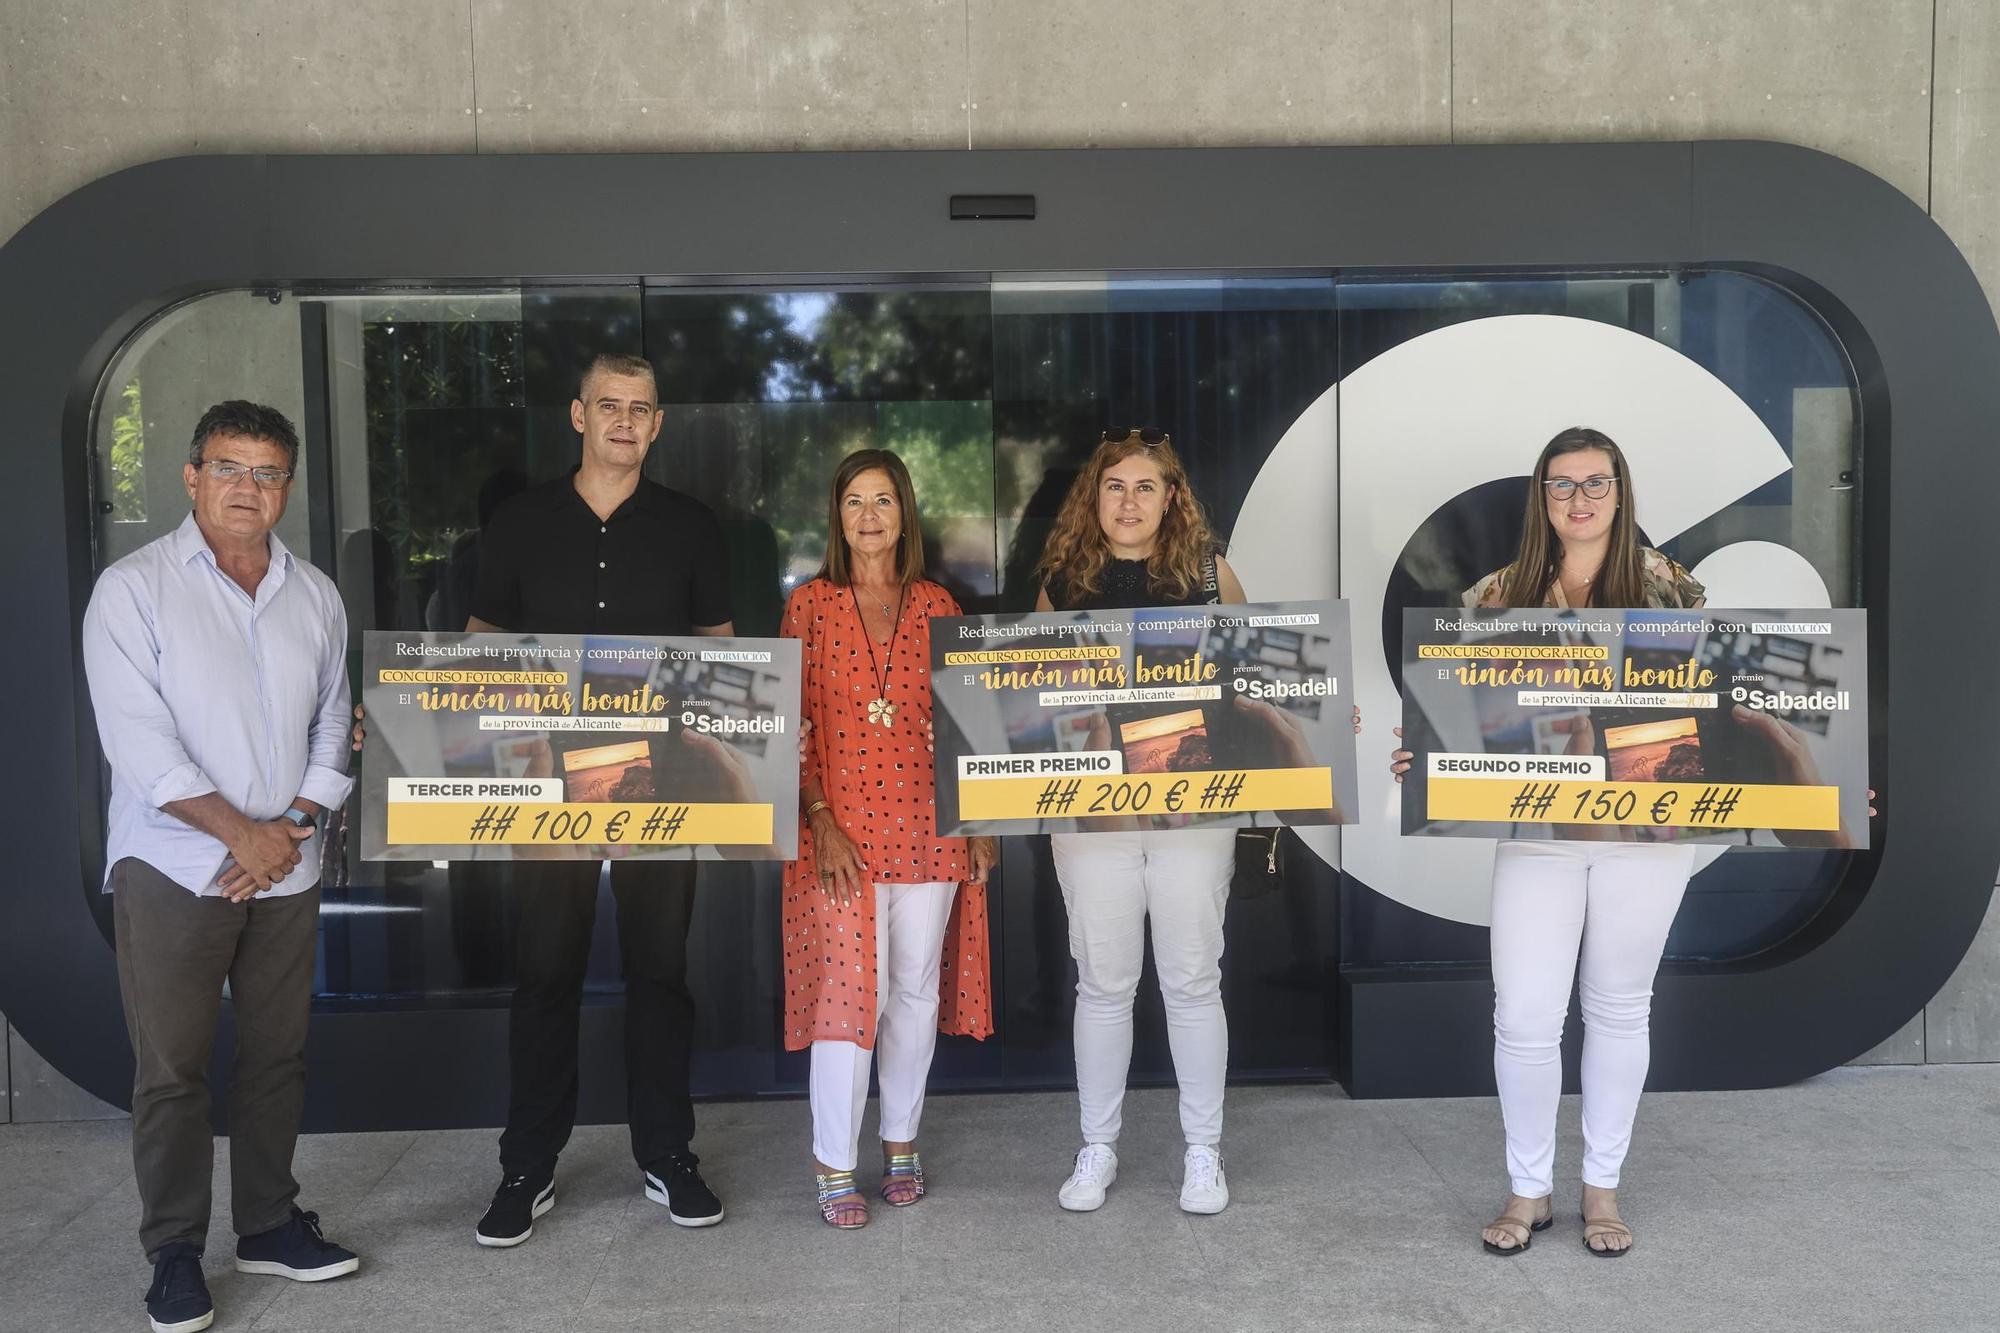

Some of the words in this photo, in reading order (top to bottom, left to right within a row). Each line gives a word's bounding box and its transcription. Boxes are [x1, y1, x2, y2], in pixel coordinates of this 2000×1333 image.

[958, 625, 1037, 639] Redescubre
[1040, 625, 1055, 635] tu
[1058, 621, 1122, 638] provincia
[1126, 623, 1135, 635] y
[1138, 616, 1216, 633] compártelo
[1219, 617, 1244, 628] con
[1252, 614, 1317, 625] INFORMACIÓN
[1435, 618, 1518, 632] Redescubre
[1522, 621, 1537, 632] tu
[1541, 619, 1611, 636] provincia
[1616, 623, 1625, 637] y
[1628, 620, 1715, 636] compártelo
[1718, 622, 1746, 633] con
[396, 643, 480, 657] Redescubre
[484, 646, 499, 657] tu
[503, 645, 571, 662] provincia
[575, 649, 584, 663] y
[588, 646, 667, 662] compártelo
[670, 650, 696, 660] con
[948, 651, 1021, 664] CONCURSO
[1422, 646, 1500, 658] CONCURSO
[383, 671, 461, 683] CONCURSO
[964, 675, 975, 685] El
[980, 663, 1067, 690] rincón
[1072, 660, 1129, 688] más
[1136, 652, 1220, 683] bonito
[1233, 665, 1261, 673] premio
[1438, 669, 1449, 680] El
[1455, 660, 1548, 687] rincón
[1554, 661, 1616, 691] más
[1624, 658, 1718, 689] bonito
[1731, 674, 1764, 683] premio
[1249, 677, 1338, 699] Sabadell
[399, 694, 411, 705] El
[416, 685, 510, 712] rincón
[515, 685, 575, 716] más
[582, 683, 669, 714] bonito
[682, 699, 710, 708] premio
[1053, 696, 1060, 704] la
[1061, 692, 1115, 705] provincia
[1128, 690, 1175, 700] Alicante
[1521, 696, 1531, 704] de
[1532, 696, 1540, 704] la
[1542, 693, 1600, 707] provincia
[1602, 696, 1612, 705] de
[1614, 694, 1666, 705] Alicante
[1748, 690, 1849, 710] Sabadell
[503, 718, 559, 730] provincia
[561, 721, 571, 729] de
[572, 718, 622, 729] Alicante
[697, 715, 785, 733] Sabadell
[966, 759, 1035, 775] PRIMER
[1040, 757, 1111, 772] PREMIO
[1437, 759, 1521, 773] SEGUNDO
[1525, 761, 1591, 774] PREMIO
[407, 784, 473, 797] TERCER
[478, 784, 543, 797] PREMIO
[1088, 781, 1151, 813] 200
[1165, 779, 1189, 812] €
[1573, 789, 1637, 820] 150
[1650, 790, 1678, 823] €
[532, 810, 592, 841] 100
[605, 810, 630, 842] €
